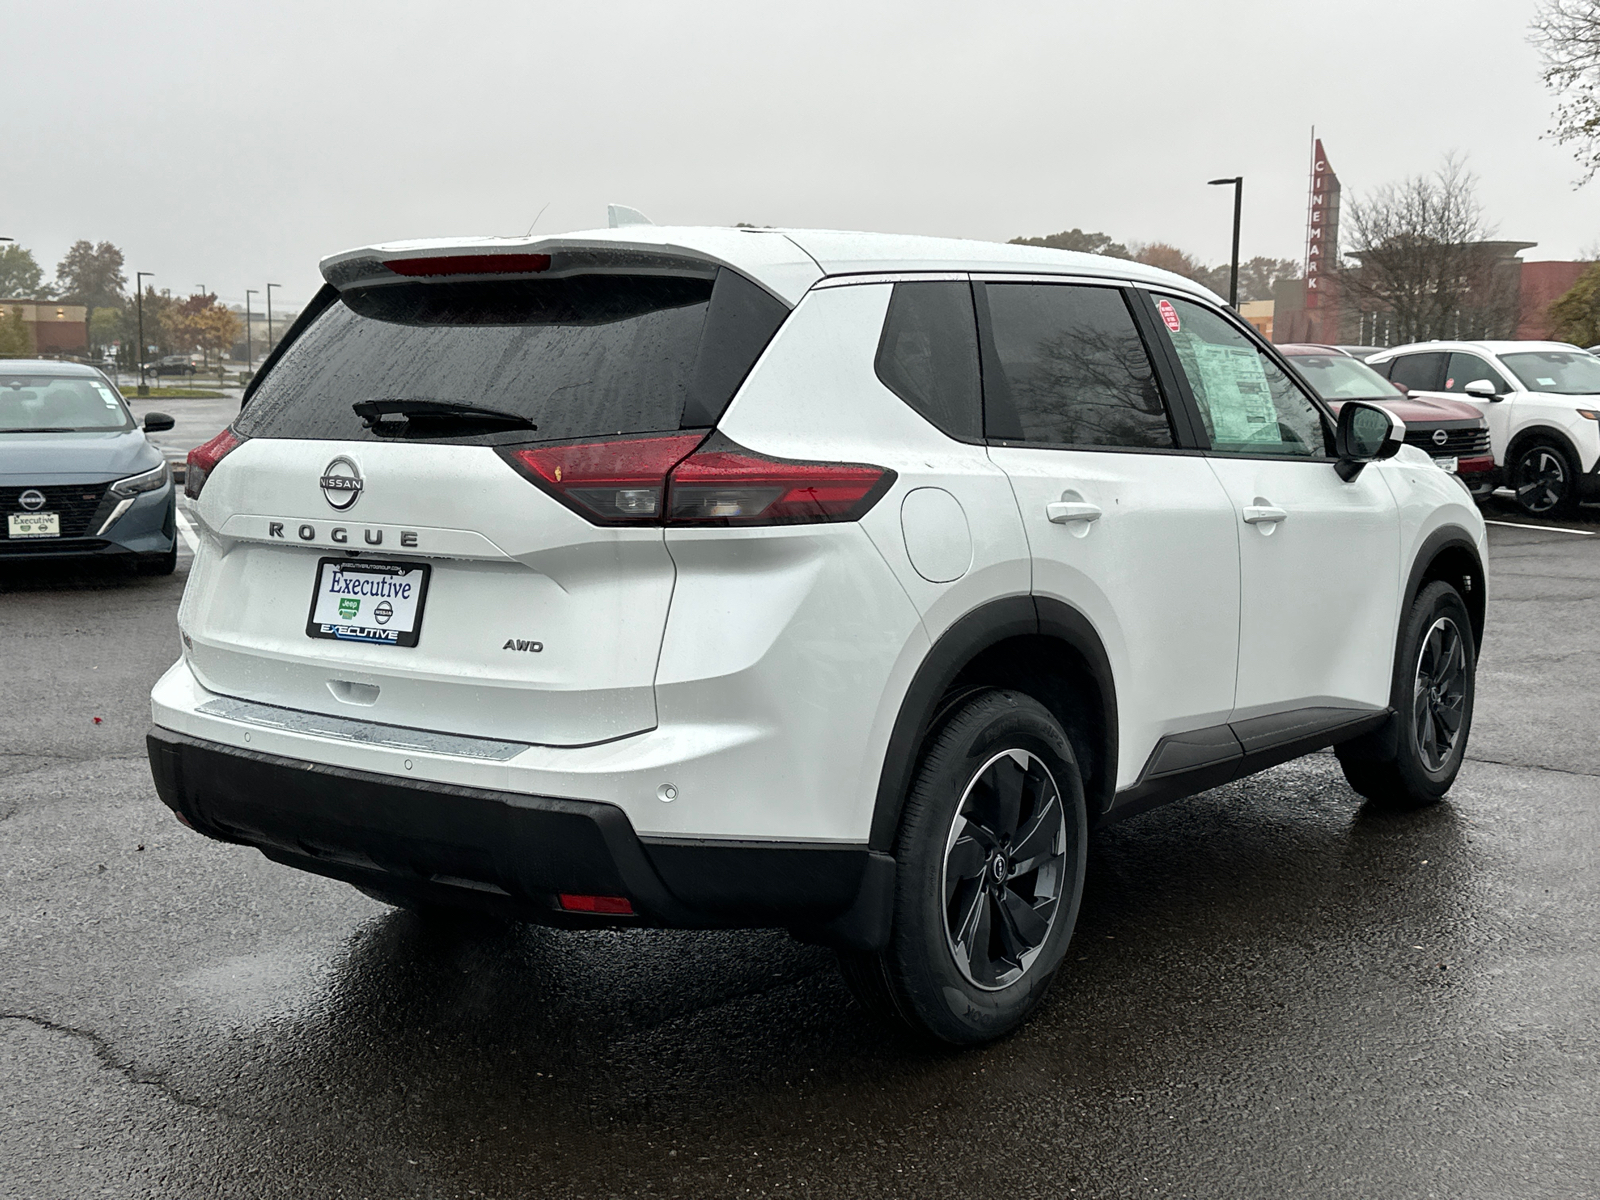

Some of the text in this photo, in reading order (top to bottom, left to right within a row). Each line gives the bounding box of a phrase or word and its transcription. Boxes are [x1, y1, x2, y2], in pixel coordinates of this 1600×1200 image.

[1308, 161, 1324, 289] CINEMARK
[320, 479, 361, 489] NISSAN
[13, 516, 54, 524] Executive
[269, 521, 419, 547] ROGUE
[329, 570, 411, 600] Executive
[342, 600, 358, 609] Jeep
[320, 624, 399, 639] EXECUTIVE
[502, 638, 543, 653] AWD
